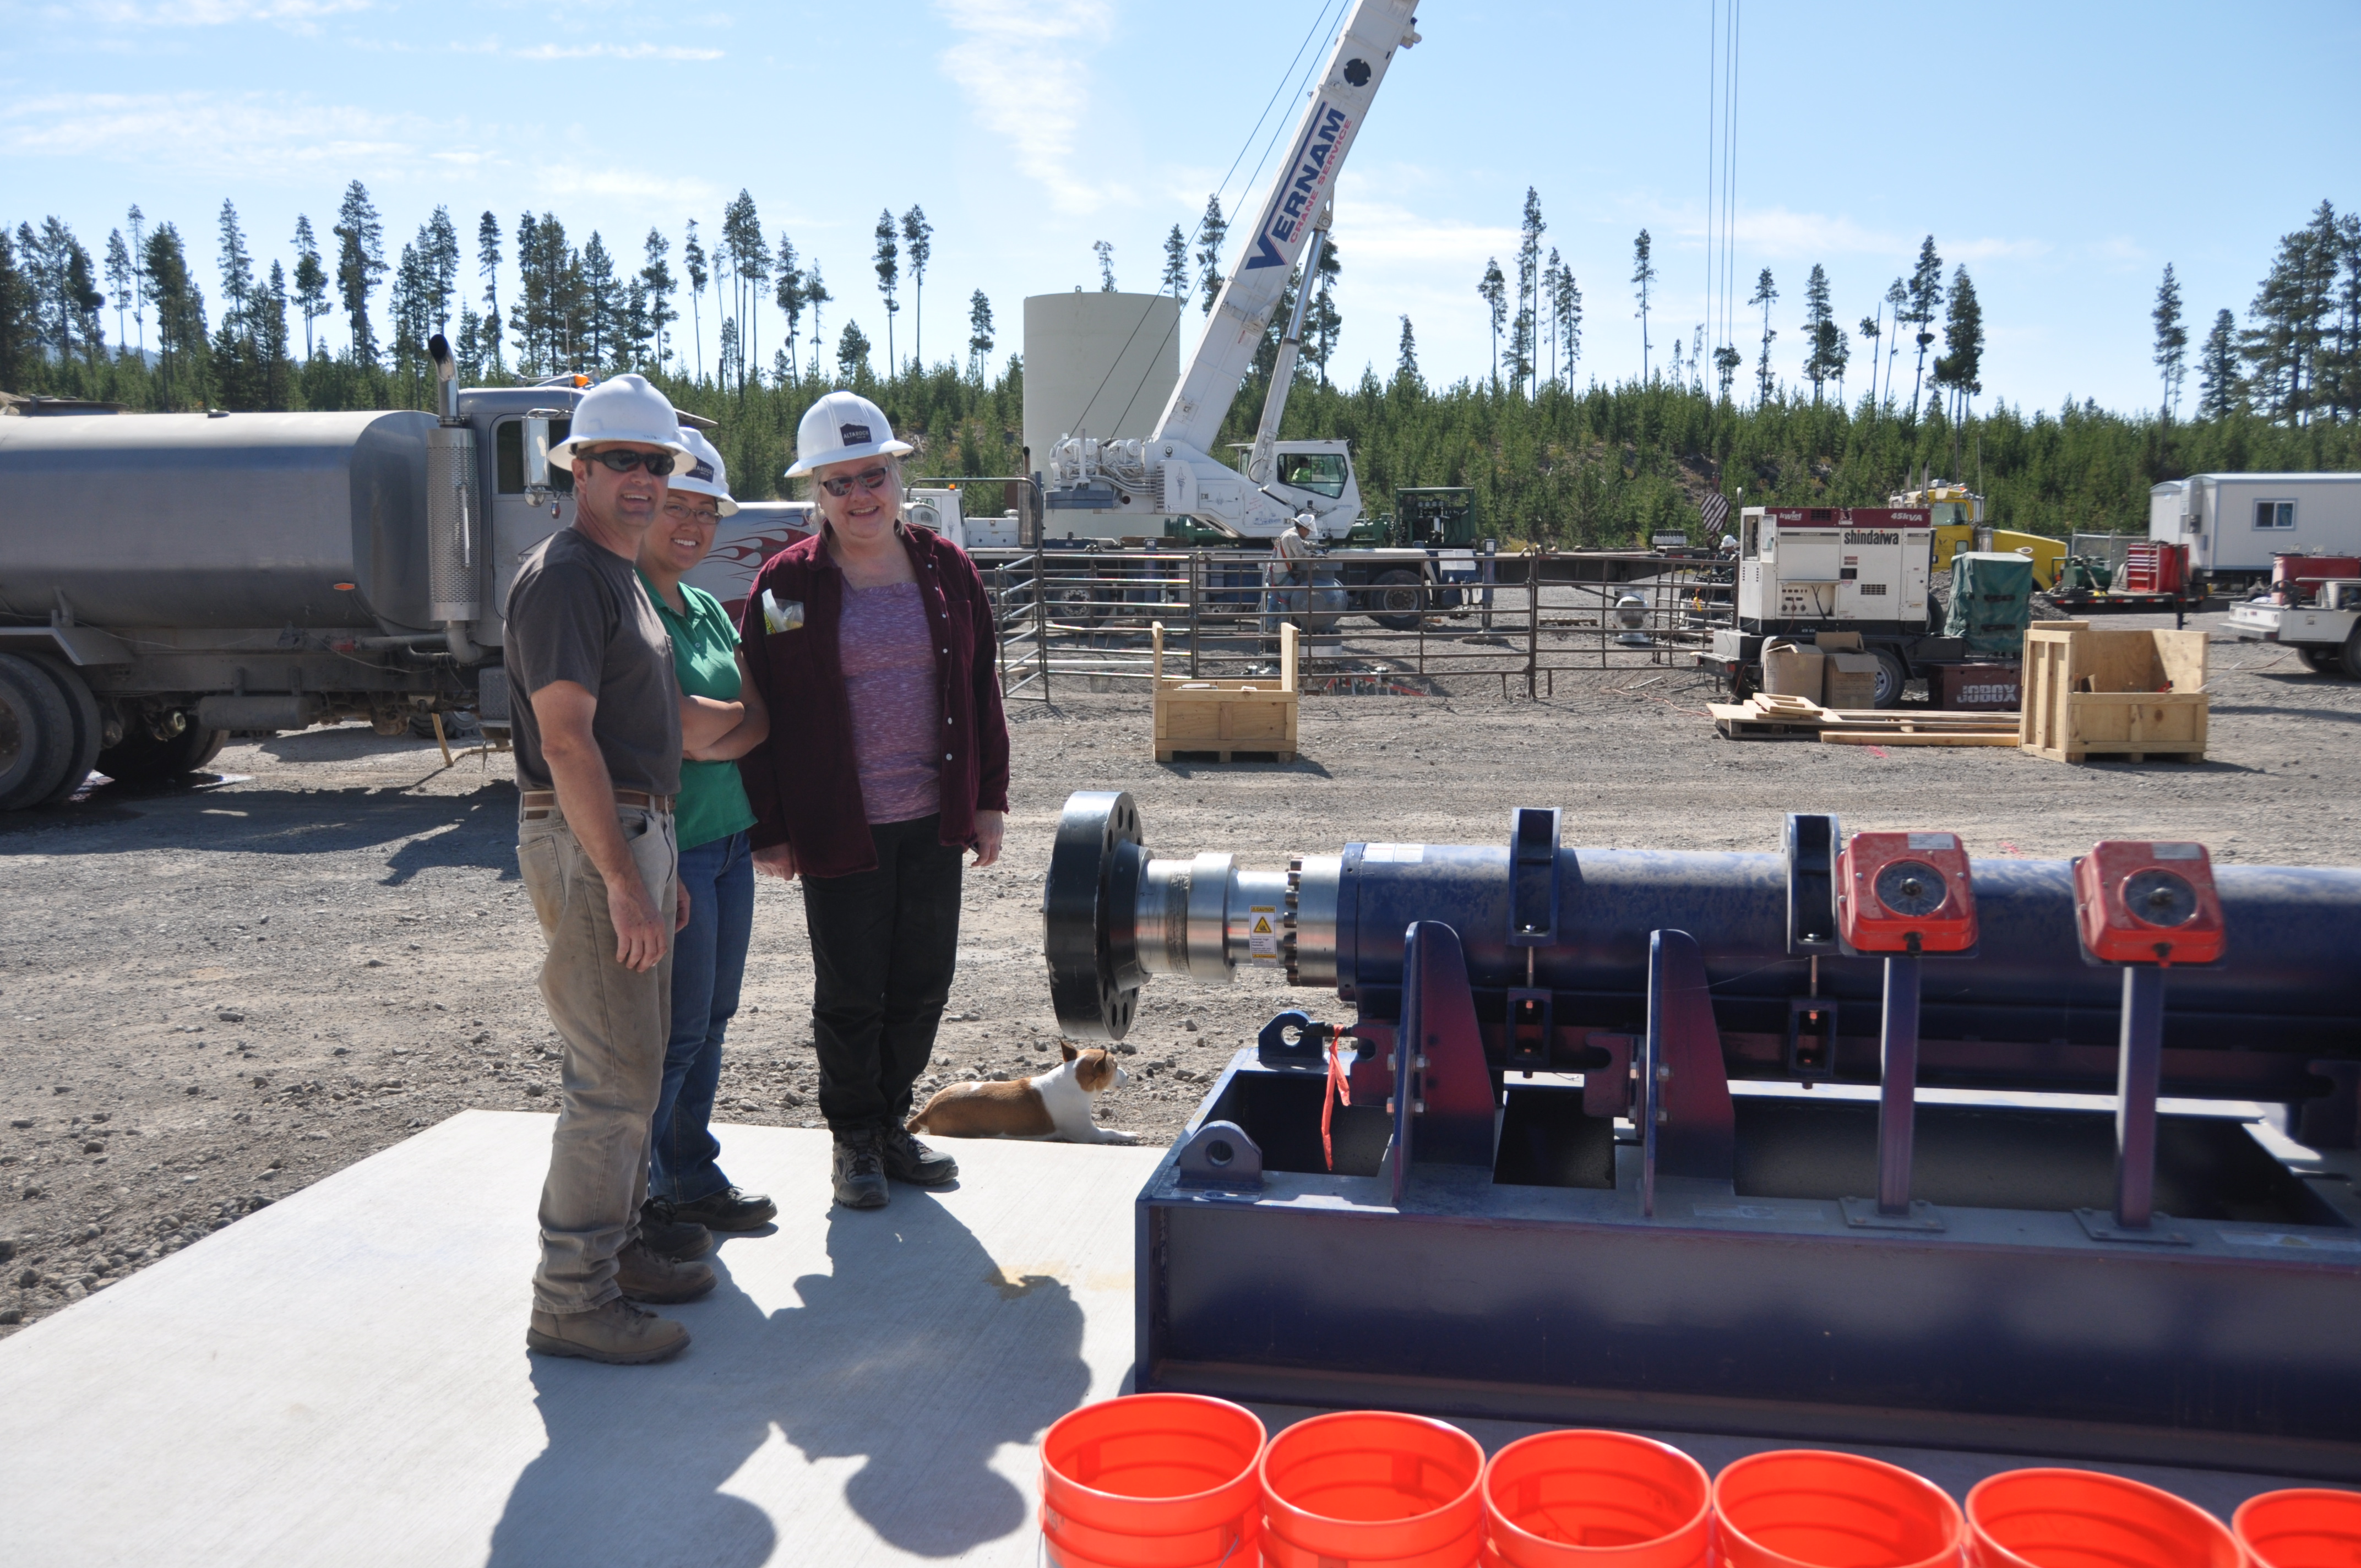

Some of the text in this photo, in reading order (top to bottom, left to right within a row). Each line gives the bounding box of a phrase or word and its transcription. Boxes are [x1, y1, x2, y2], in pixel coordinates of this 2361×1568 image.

[1245, 101, 1346, 270] VERNAM
[1290, 118, 1352, 243] CRANE SERVICE
[844, 431, 869, 439] ALTAROCK
[1891, 513, 1922, 521] 45kVA
[1844, 529, 1899, 545] shindaiwa
[1956, 684, 2017, 703] JOBOX
